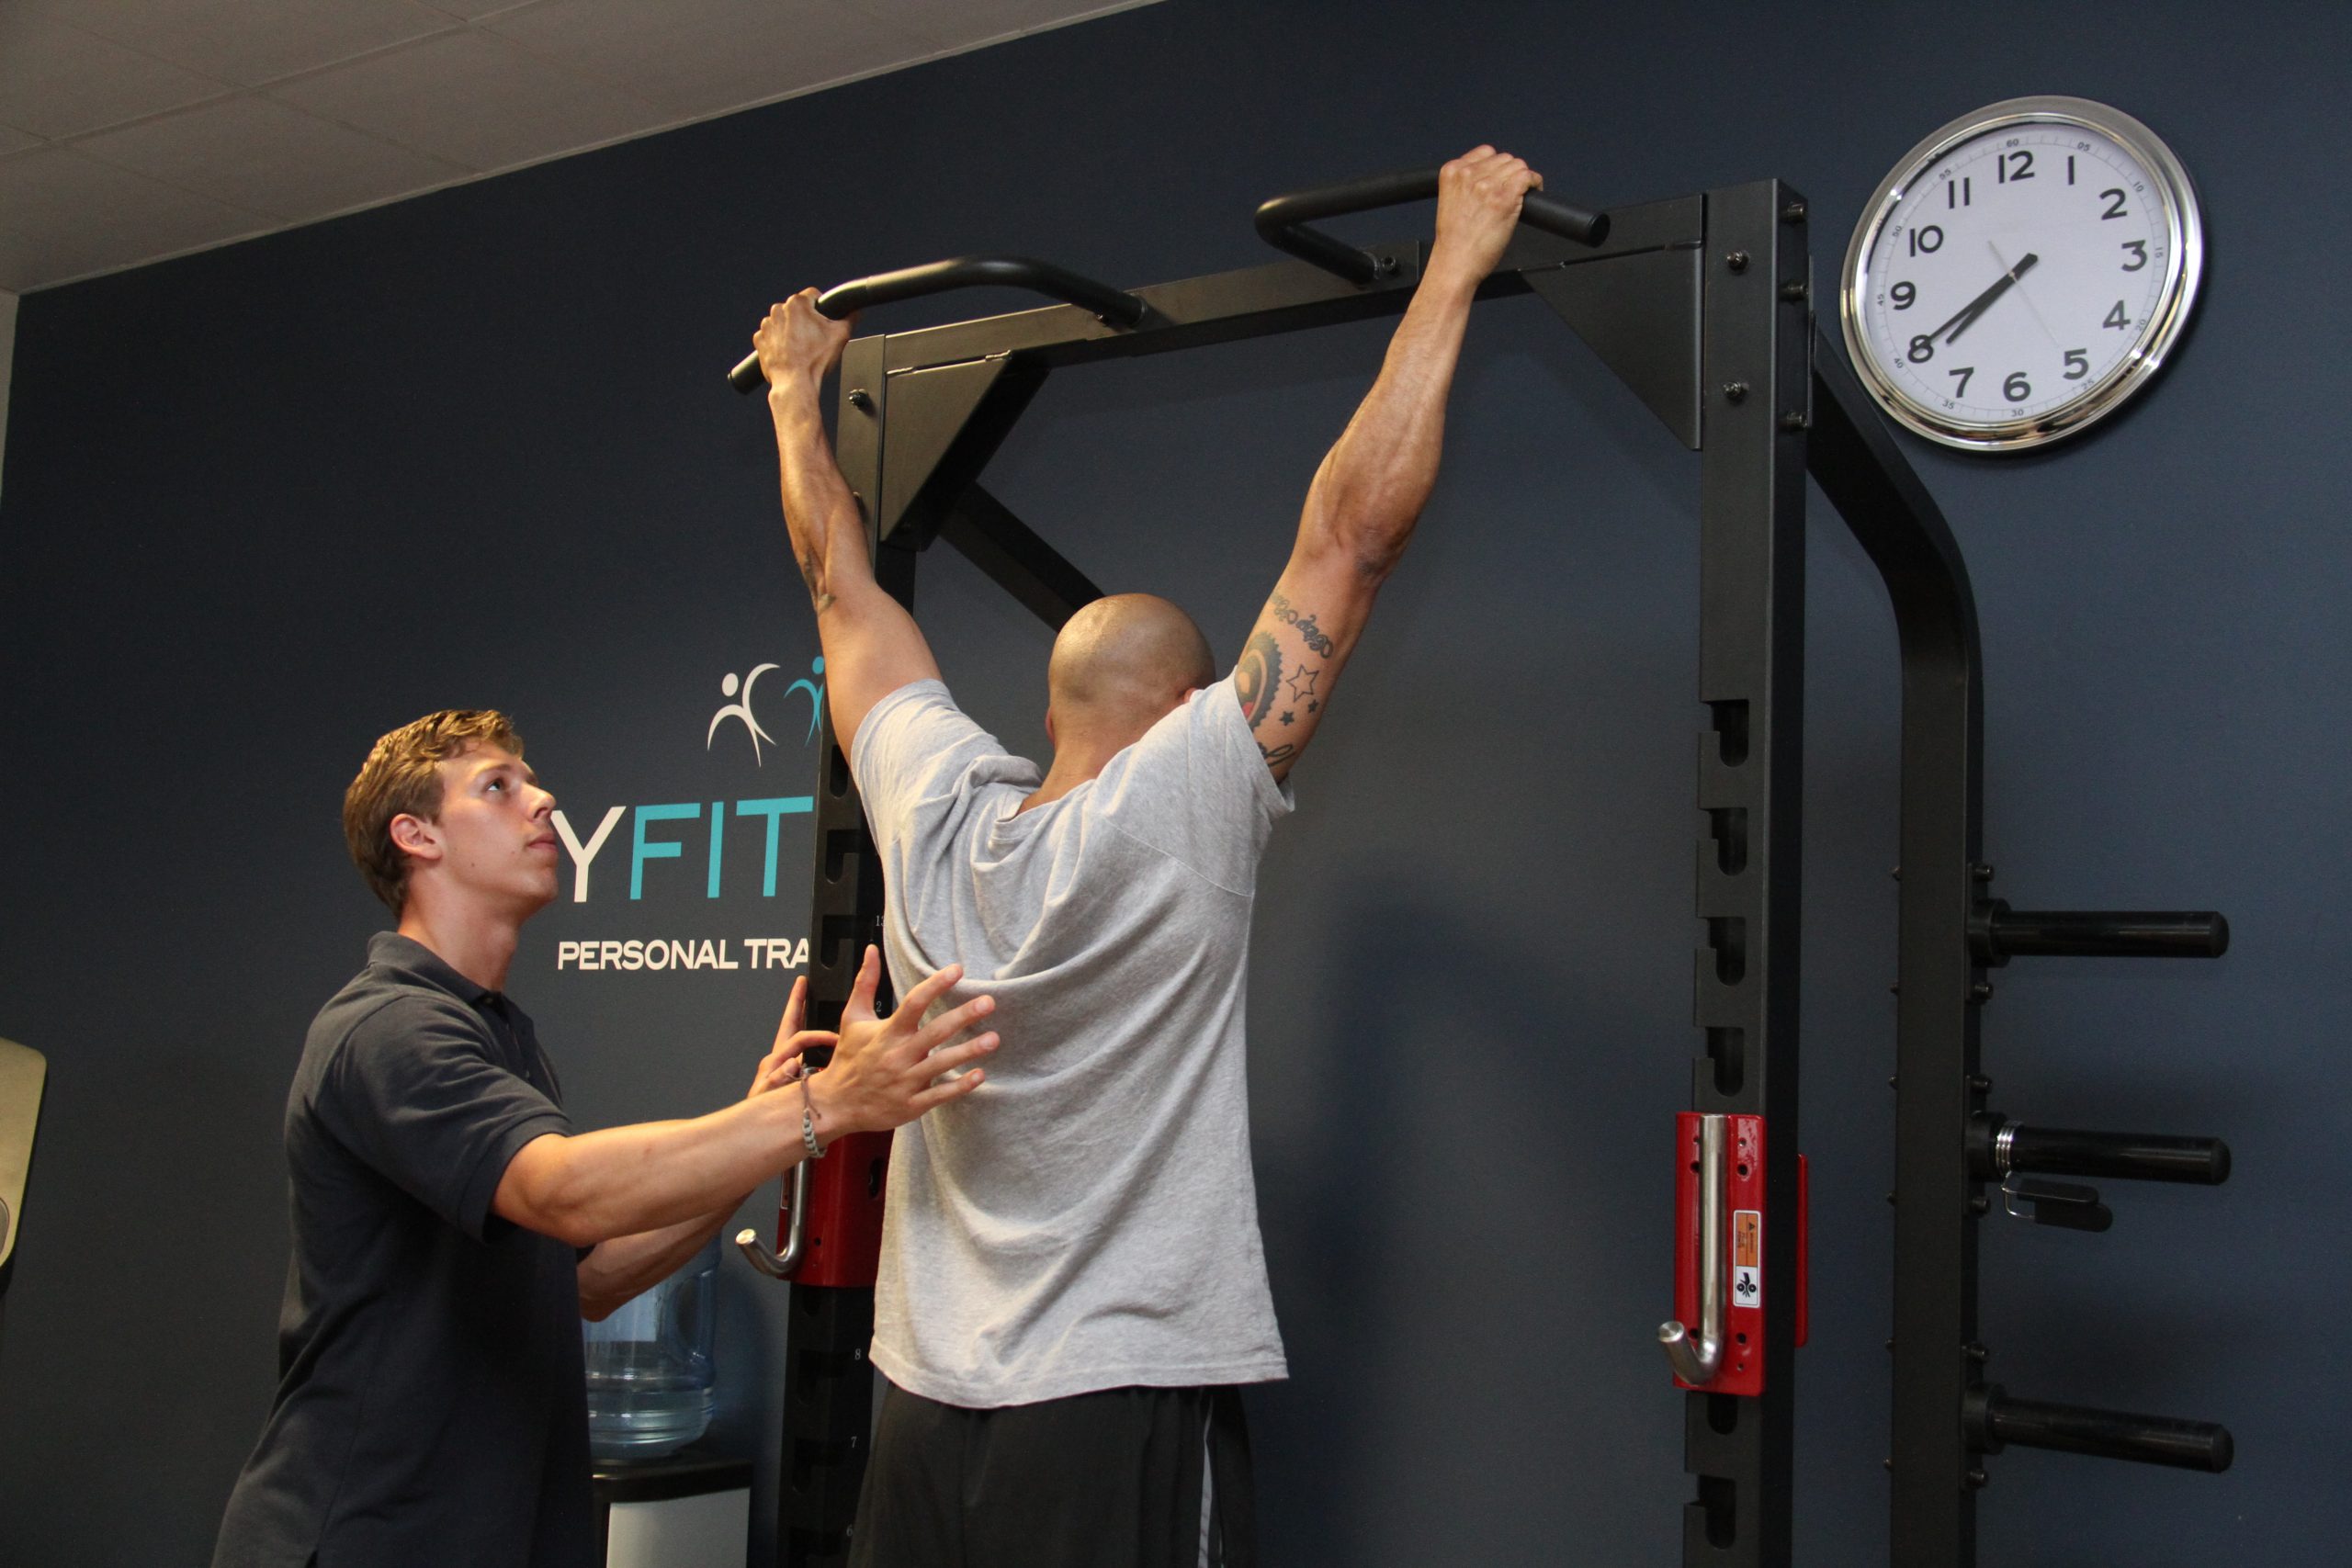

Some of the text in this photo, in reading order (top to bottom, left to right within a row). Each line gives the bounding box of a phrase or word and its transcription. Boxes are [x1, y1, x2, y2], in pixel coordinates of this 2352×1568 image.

[2007, 138, 2019, 148] 60
[2077, 141, 2091, 152] 05
[1998, 150, 2035, 184] 12
[2067, 155, 2075, 185] 1
[1948, 176, 1970, 209] 11
[2133, 181, 2144, 193] 10
[2099, 188, 2128, 220] 2
[1892, 226, 1903, 238] 50
[1909, 225, 1943, 257] 10
[2121, 240, 2147, 272] 3
[1891, 281, 1916, 310] 9
[2102, 299, 2131, 331] 4
[1907, 334, 1935, 364] 8
[2064, 348, 2089, 380] 5
[1949, 367, 1974, 398] 7
[2003, 371, 2031, 402] 6
[1942, 400, 1954, 410] 35
[2011, 408, 2025, 418] 30
[558, 939, 739, 970] PERSONAL
[854, 1348, 861, 1360] 8
[851, 1436, 857, 1449] 7
